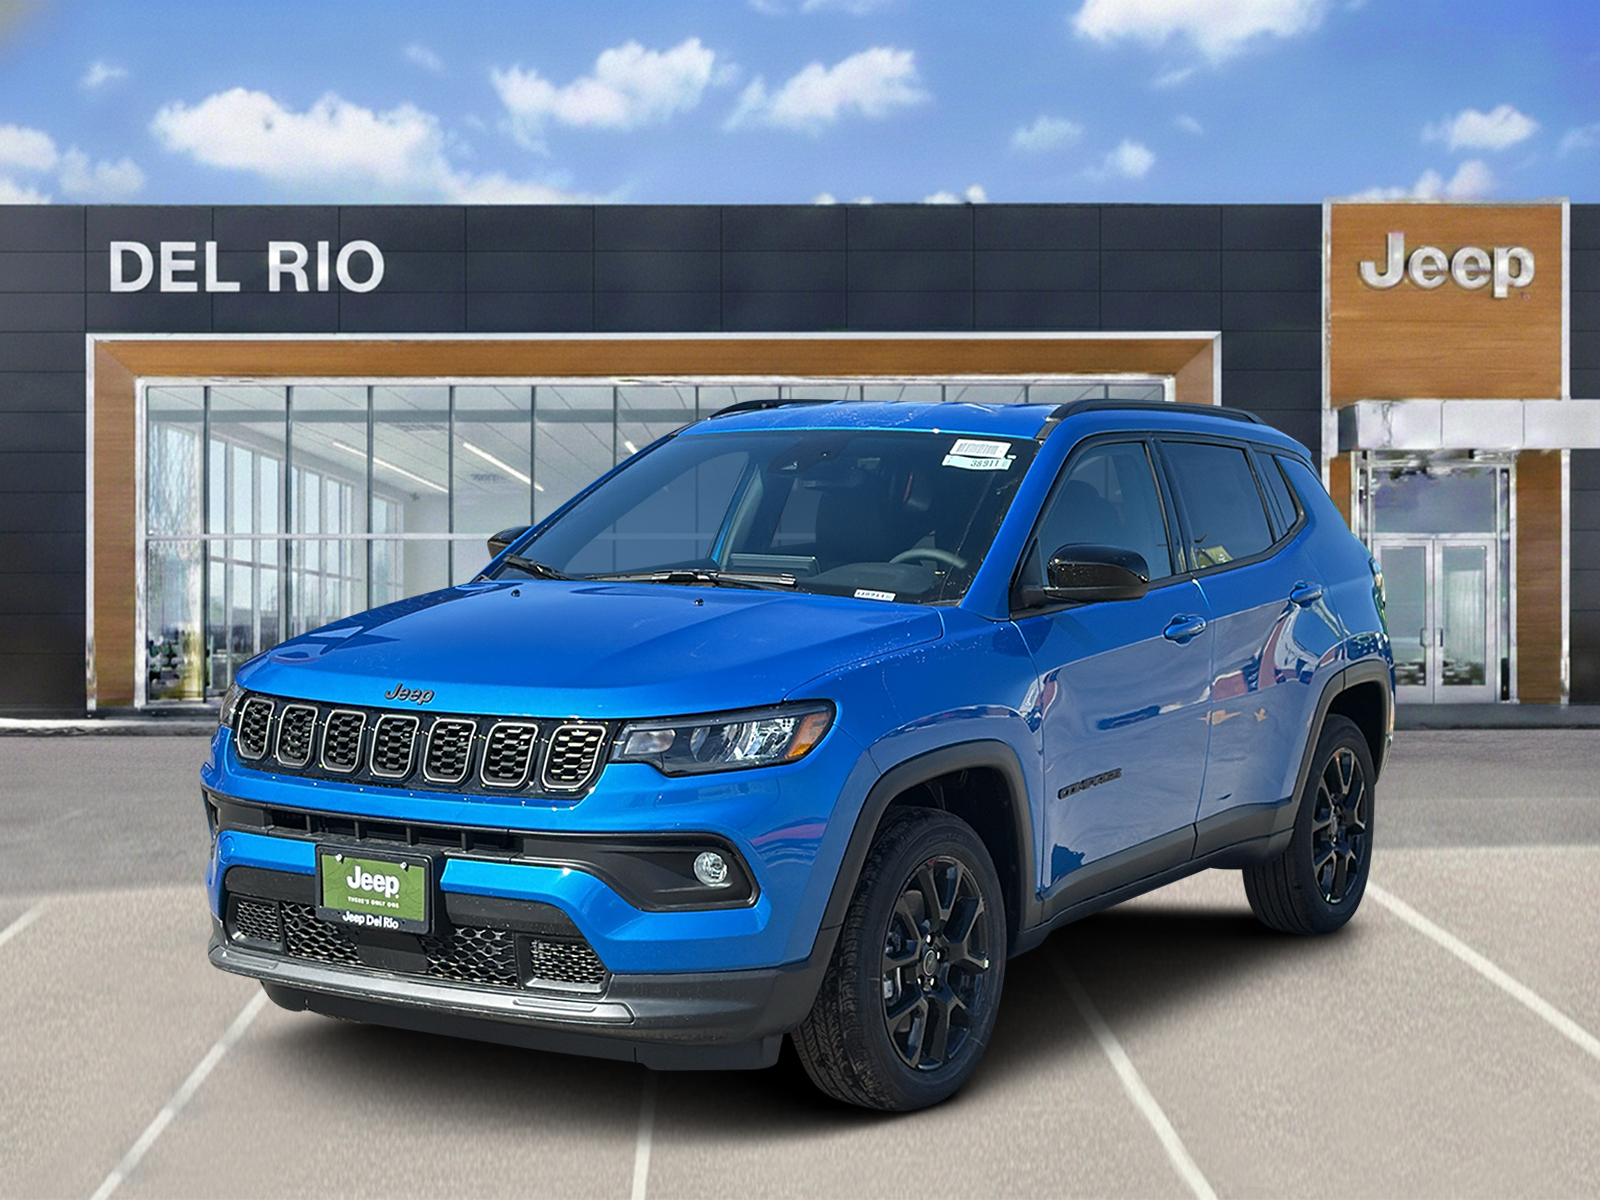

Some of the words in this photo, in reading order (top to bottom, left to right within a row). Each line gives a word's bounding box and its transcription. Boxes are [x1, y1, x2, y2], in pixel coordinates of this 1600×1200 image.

[110, 241, 240, 292] DEL
[268, 240, 385, 293] RIO
[1359, 231, 1535, 299] Jeep
[385, 683, 434, 706] Jeep
[346, 865, 399, 898] Jeep
[342, 910, 366, 926] Jeep
[366, 914, 383, 928] Del
[383, 916, 399, 929] Rio
